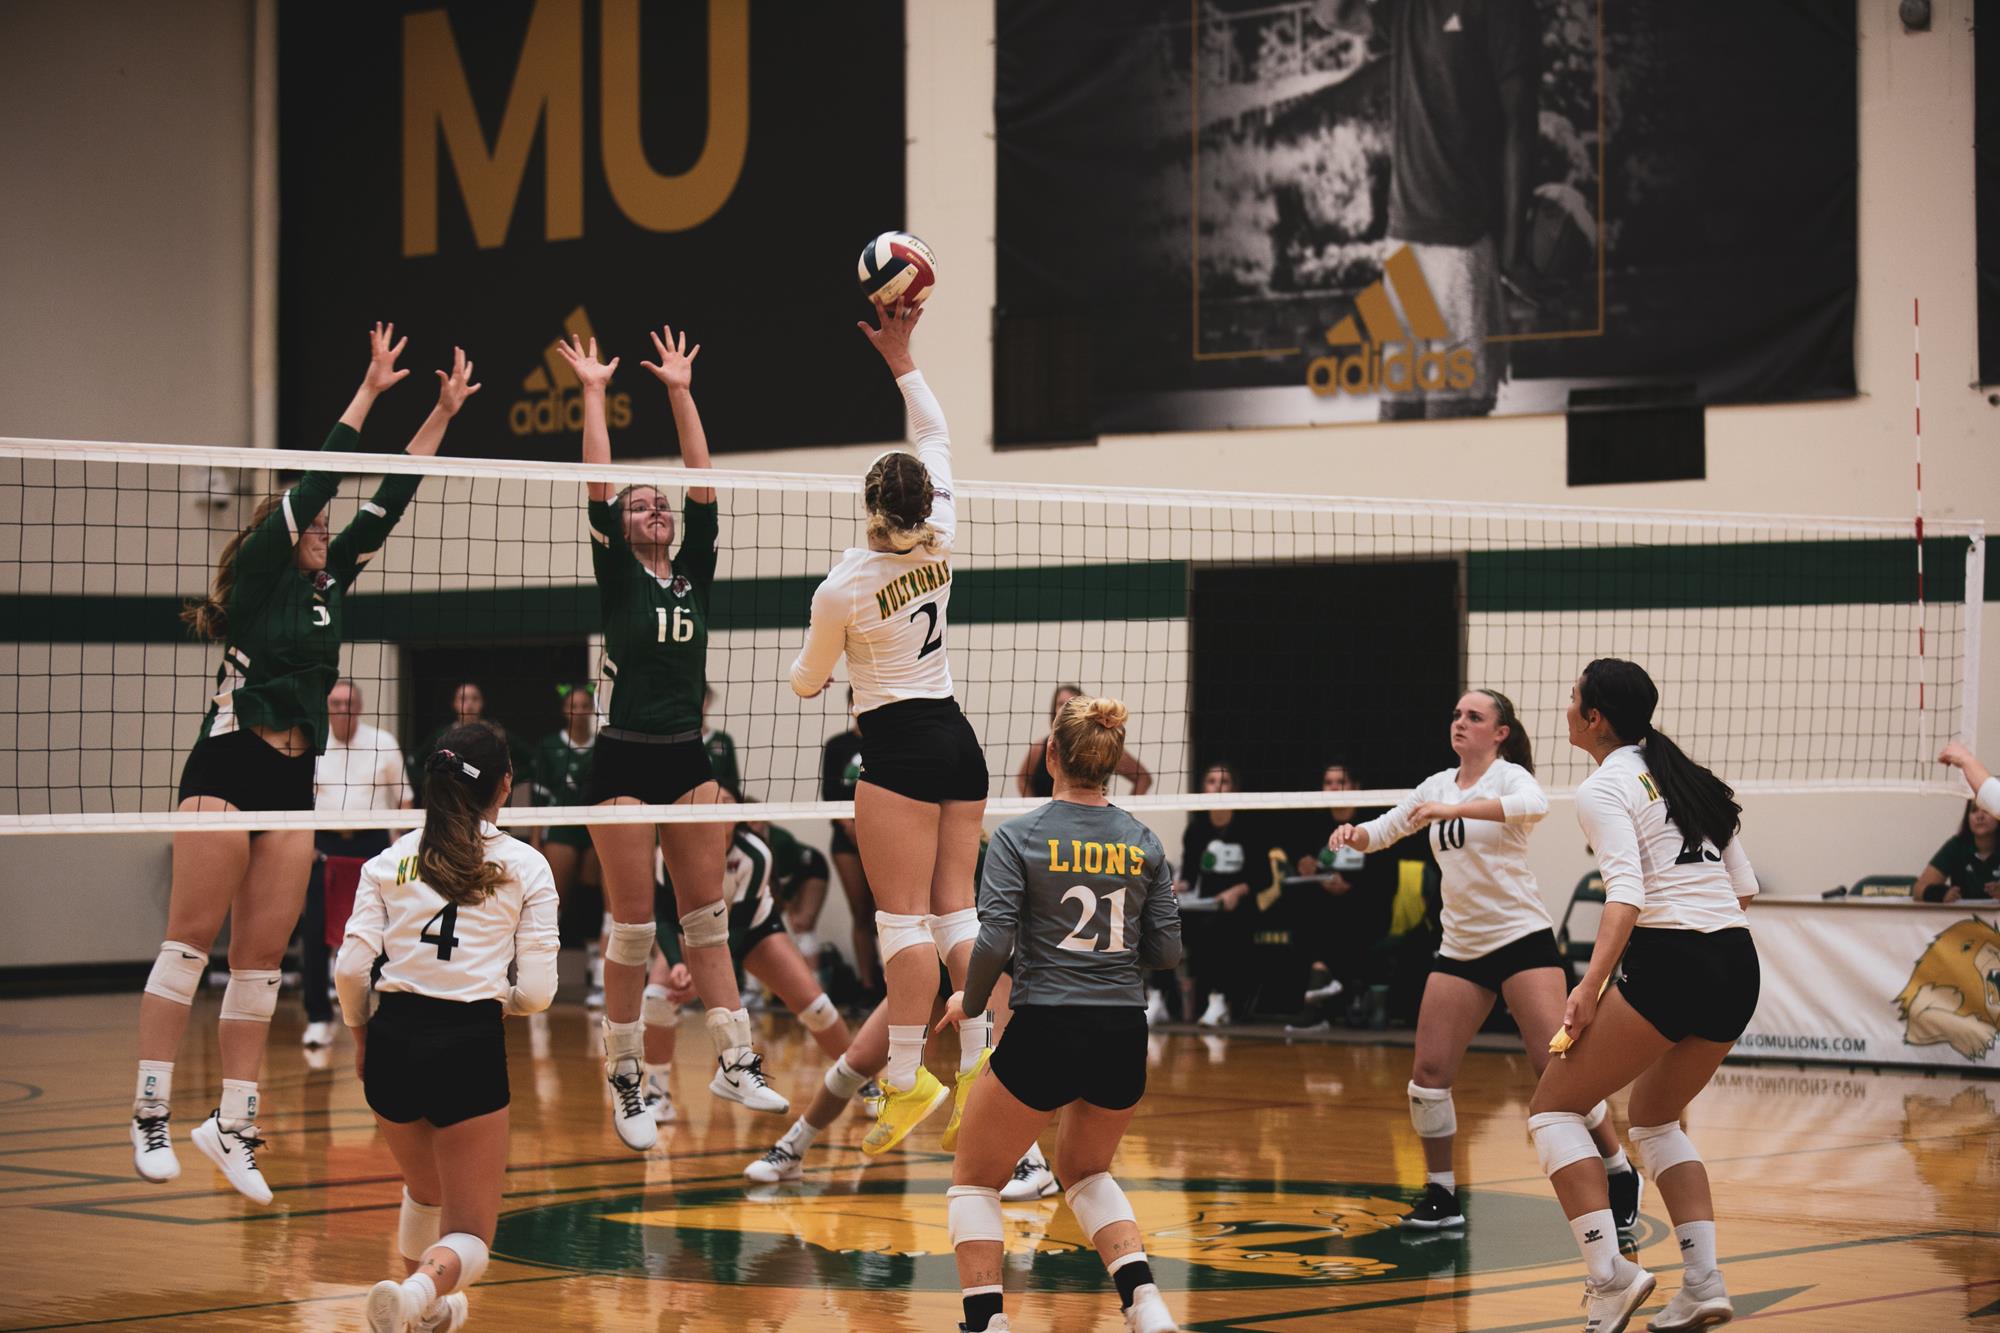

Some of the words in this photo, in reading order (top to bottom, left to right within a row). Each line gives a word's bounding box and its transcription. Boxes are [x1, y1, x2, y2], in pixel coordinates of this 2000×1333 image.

[403, 0, 749, 258] MU
[1307, 341, 1476, 397] adidas
[510, 388, 632, 434] adids
[656, 605, 694, 642] 16
[910, 601, 942, 661] 2
[1048, 839, 1145, 876] LIONS
[1436, 816, 1465, 852] 10
[420, 900, 459, 961] 4
[1056, 885, 1131, 953] 21
